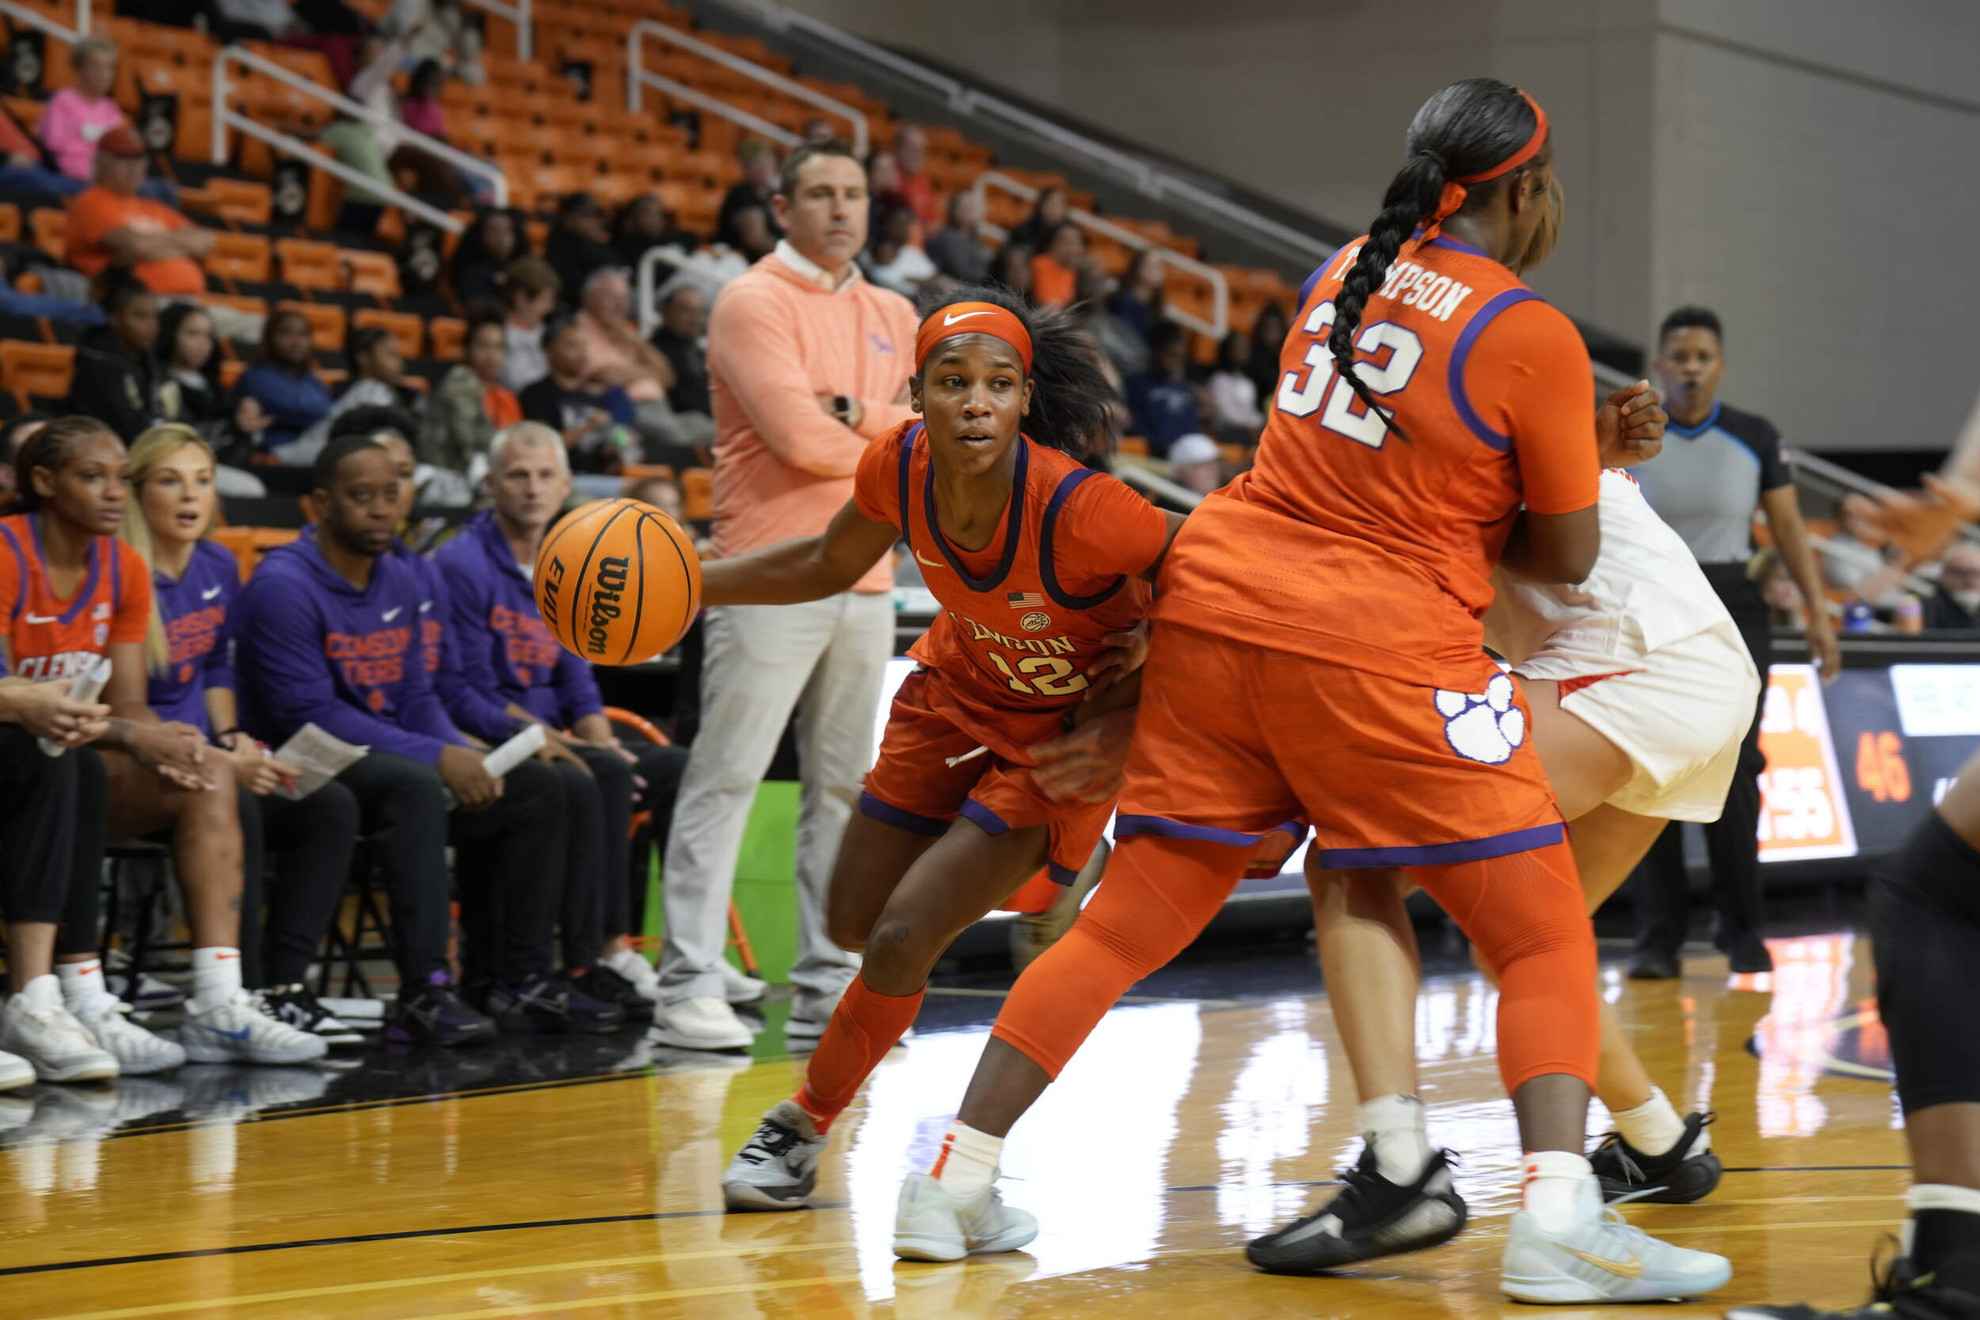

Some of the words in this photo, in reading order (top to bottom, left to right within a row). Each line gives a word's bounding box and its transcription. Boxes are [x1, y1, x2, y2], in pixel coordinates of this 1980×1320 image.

[1277, 299, 1425, 451] 32
[587, 556, 630, 656] Wilson
[987, 650, 1091, 697] 12
[1855, 731, 1912, 803] 46
